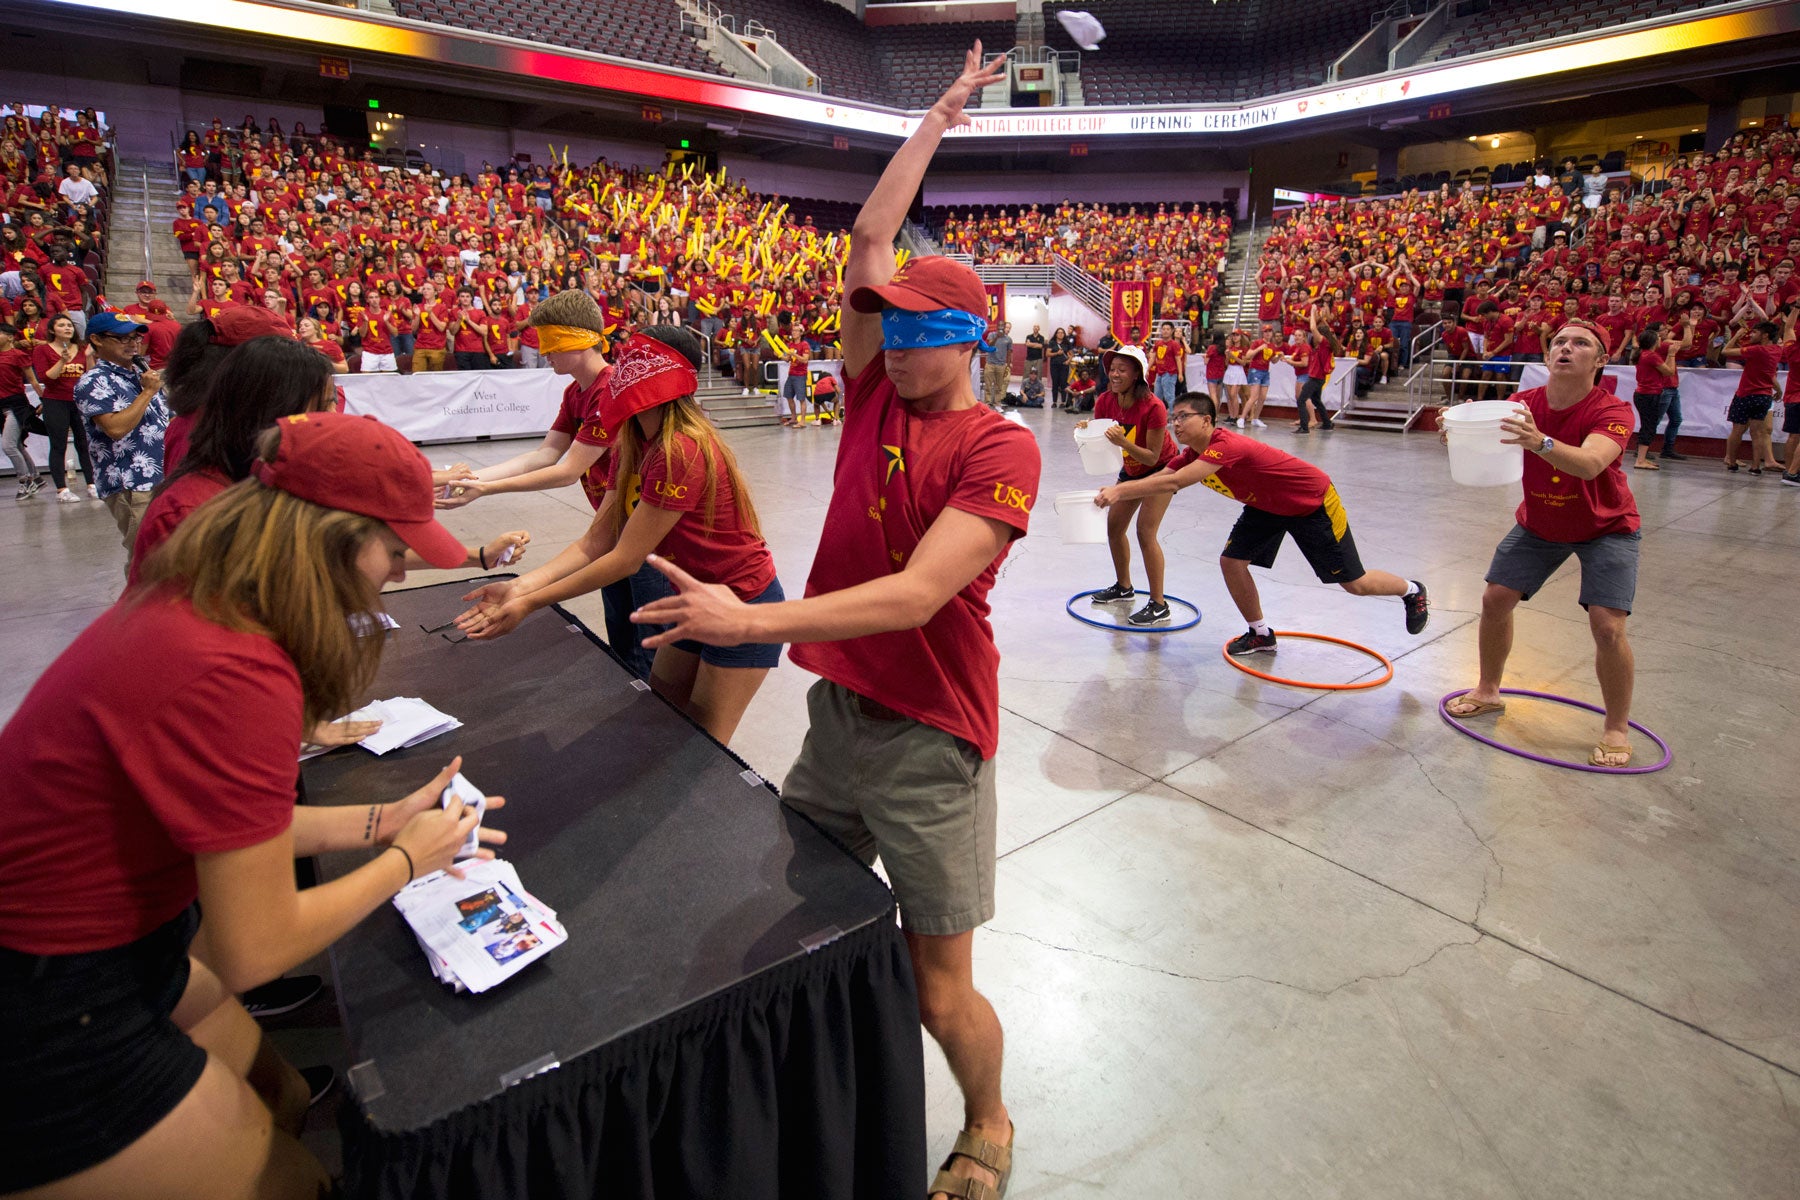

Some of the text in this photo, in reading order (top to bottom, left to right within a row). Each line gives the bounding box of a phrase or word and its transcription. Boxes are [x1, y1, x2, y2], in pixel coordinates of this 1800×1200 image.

[320, 64, 349, 77] 115
[1017, 118, 1072, 133] COLLEGE
[1078, 116, 1106, 131] CUP
[1130, 115, 1192, 130] OPENING
[1204, 106, 1278, 129] CEREMONY
[473, 391, 497, 401] West
[443, 402, 531, 416] Residential College
[592, 426, 608, 439] US
[1204, 449, 1223, 459] USC
[655, 480, 688, 499] USC
